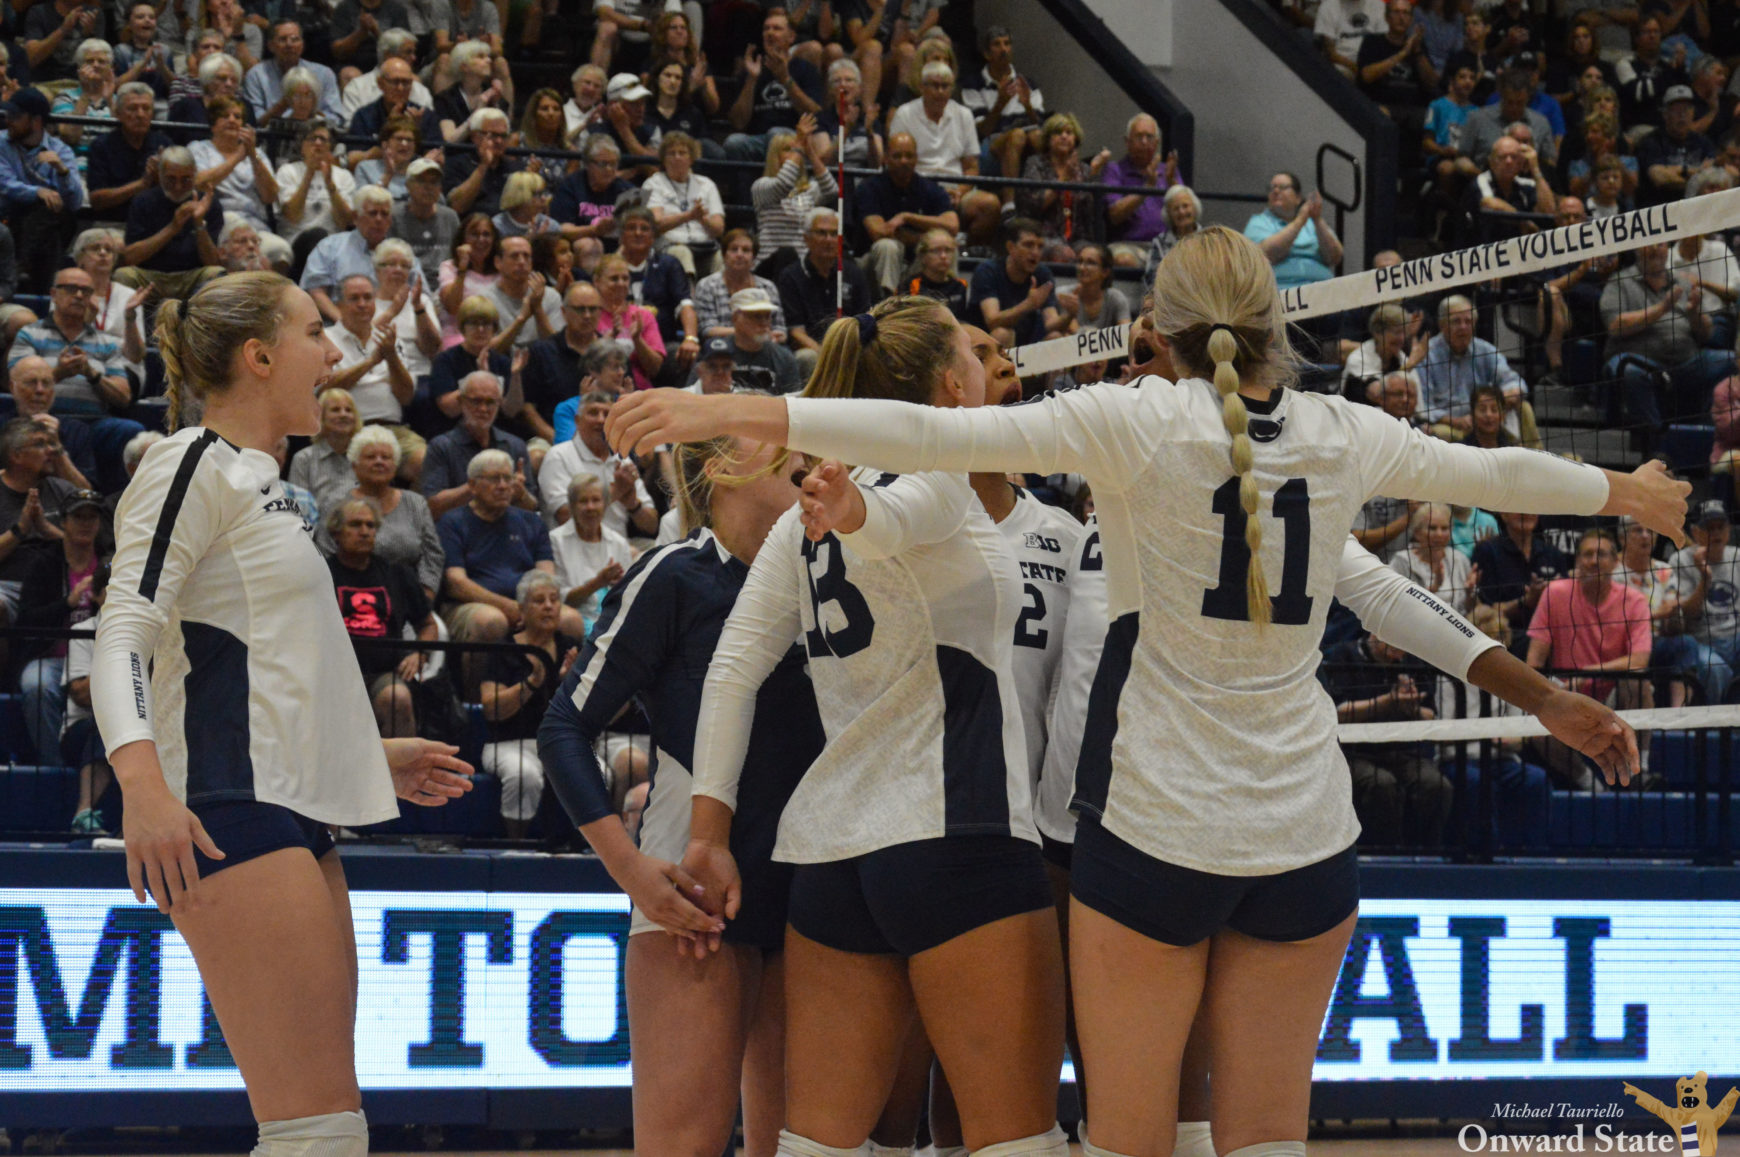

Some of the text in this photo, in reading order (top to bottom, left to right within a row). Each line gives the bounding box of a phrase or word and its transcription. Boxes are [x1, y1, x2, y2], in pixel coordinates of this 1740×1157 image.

[1374, 205, 1678, 294] PENN STATE VOLLEYBALL
[1077, 325, 1123, 357] PENN
[1019, 561, 1067, 584] TATE
[1200, 475, 1314, 625] 11
[801, 526, 876, 659] 13
[1405, 586, 1476, 639] NITTANY LIONS
[130, 651, 147, 721] NITTANY LIONS
[381, 909, 632, 1068] TO
[1316, 915, 1649, 1063] ALL
